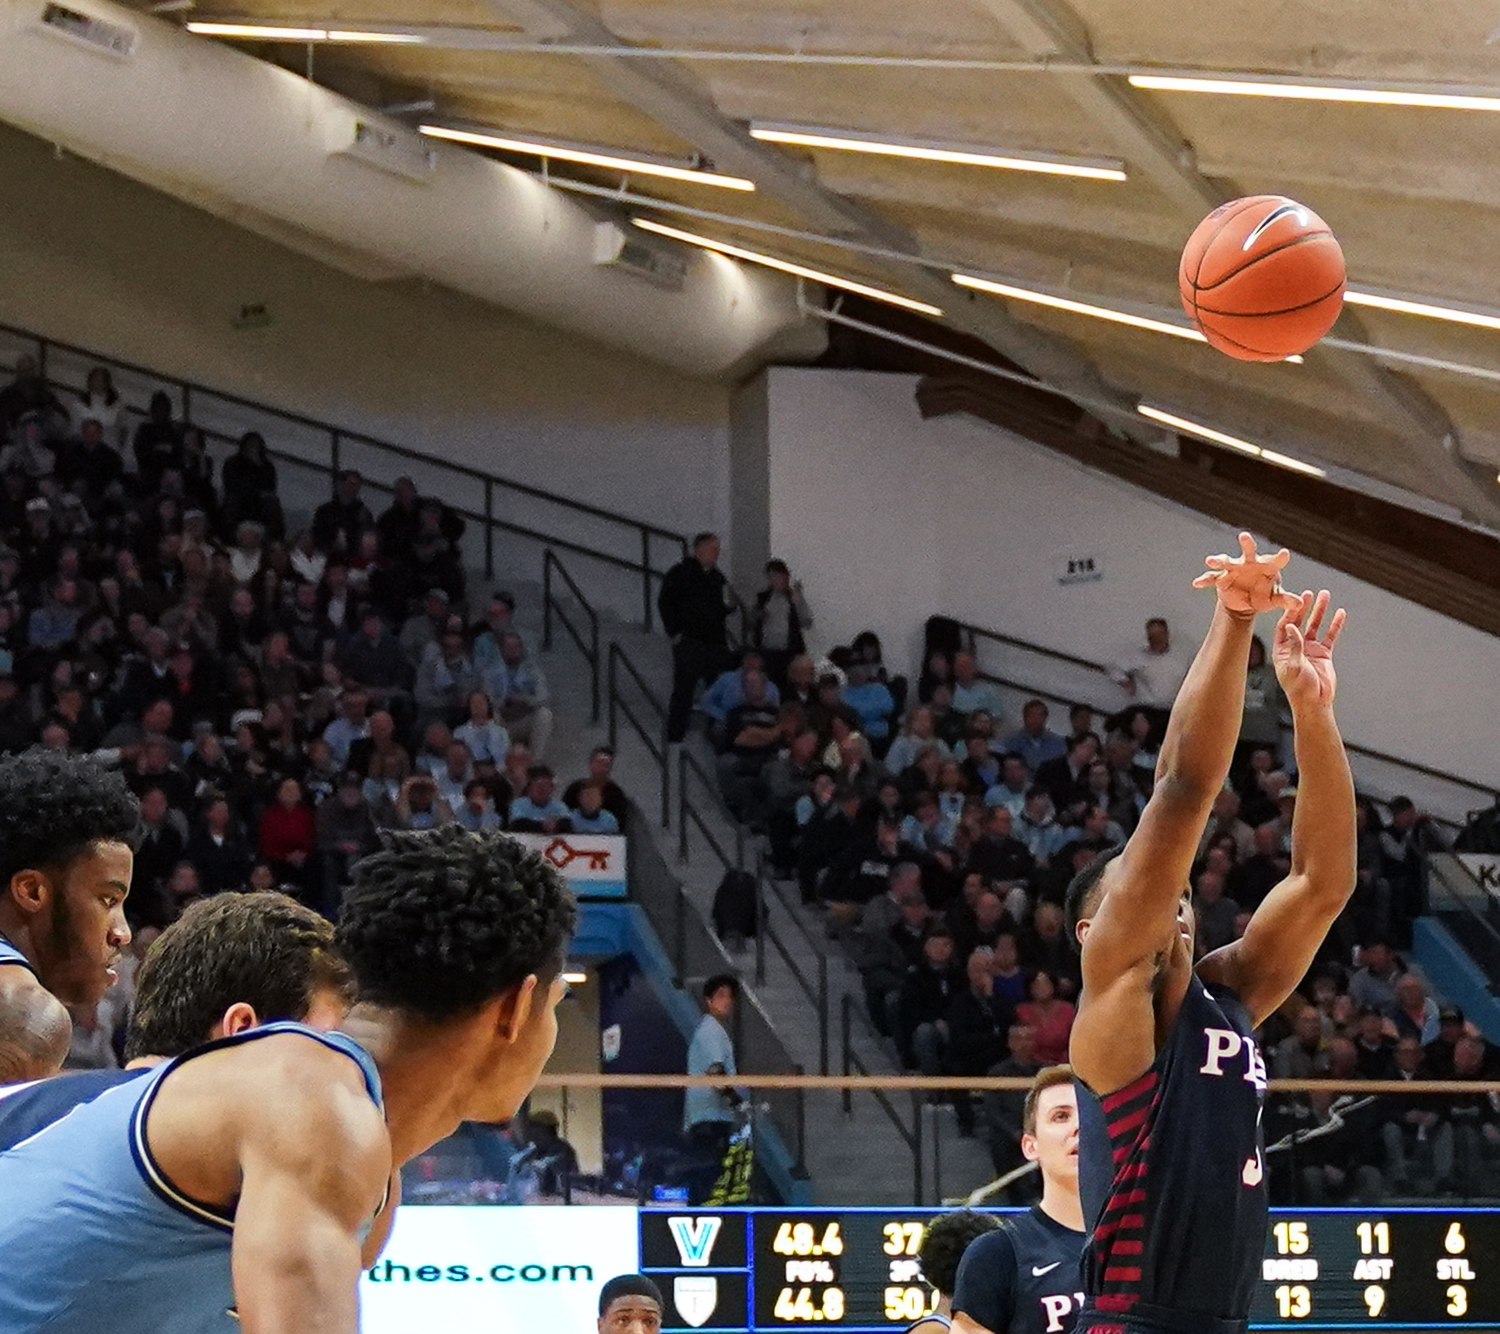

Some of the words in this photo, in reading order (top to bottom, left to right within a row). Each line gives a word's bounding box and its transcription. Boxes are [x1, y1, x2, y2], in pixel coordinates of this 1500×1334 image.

[773, 1222, 843, 1256] 48.4
[1273, 1222, 1309, 1255] 15
[1356, 1222, 1390, 1255] 11
[1444, 1222, 1466, 1255] 6
[1353, 1259, 1394, 1280] AST
[1436, 1259, 1476, 1280] STL
[774, 1287, 844, 1321] 44.8
[1274, 1285, 1311, 1318] 13
[1364, 1285, 1386, 1317] 9
[1446, 1284, 1468, 1317] 3
